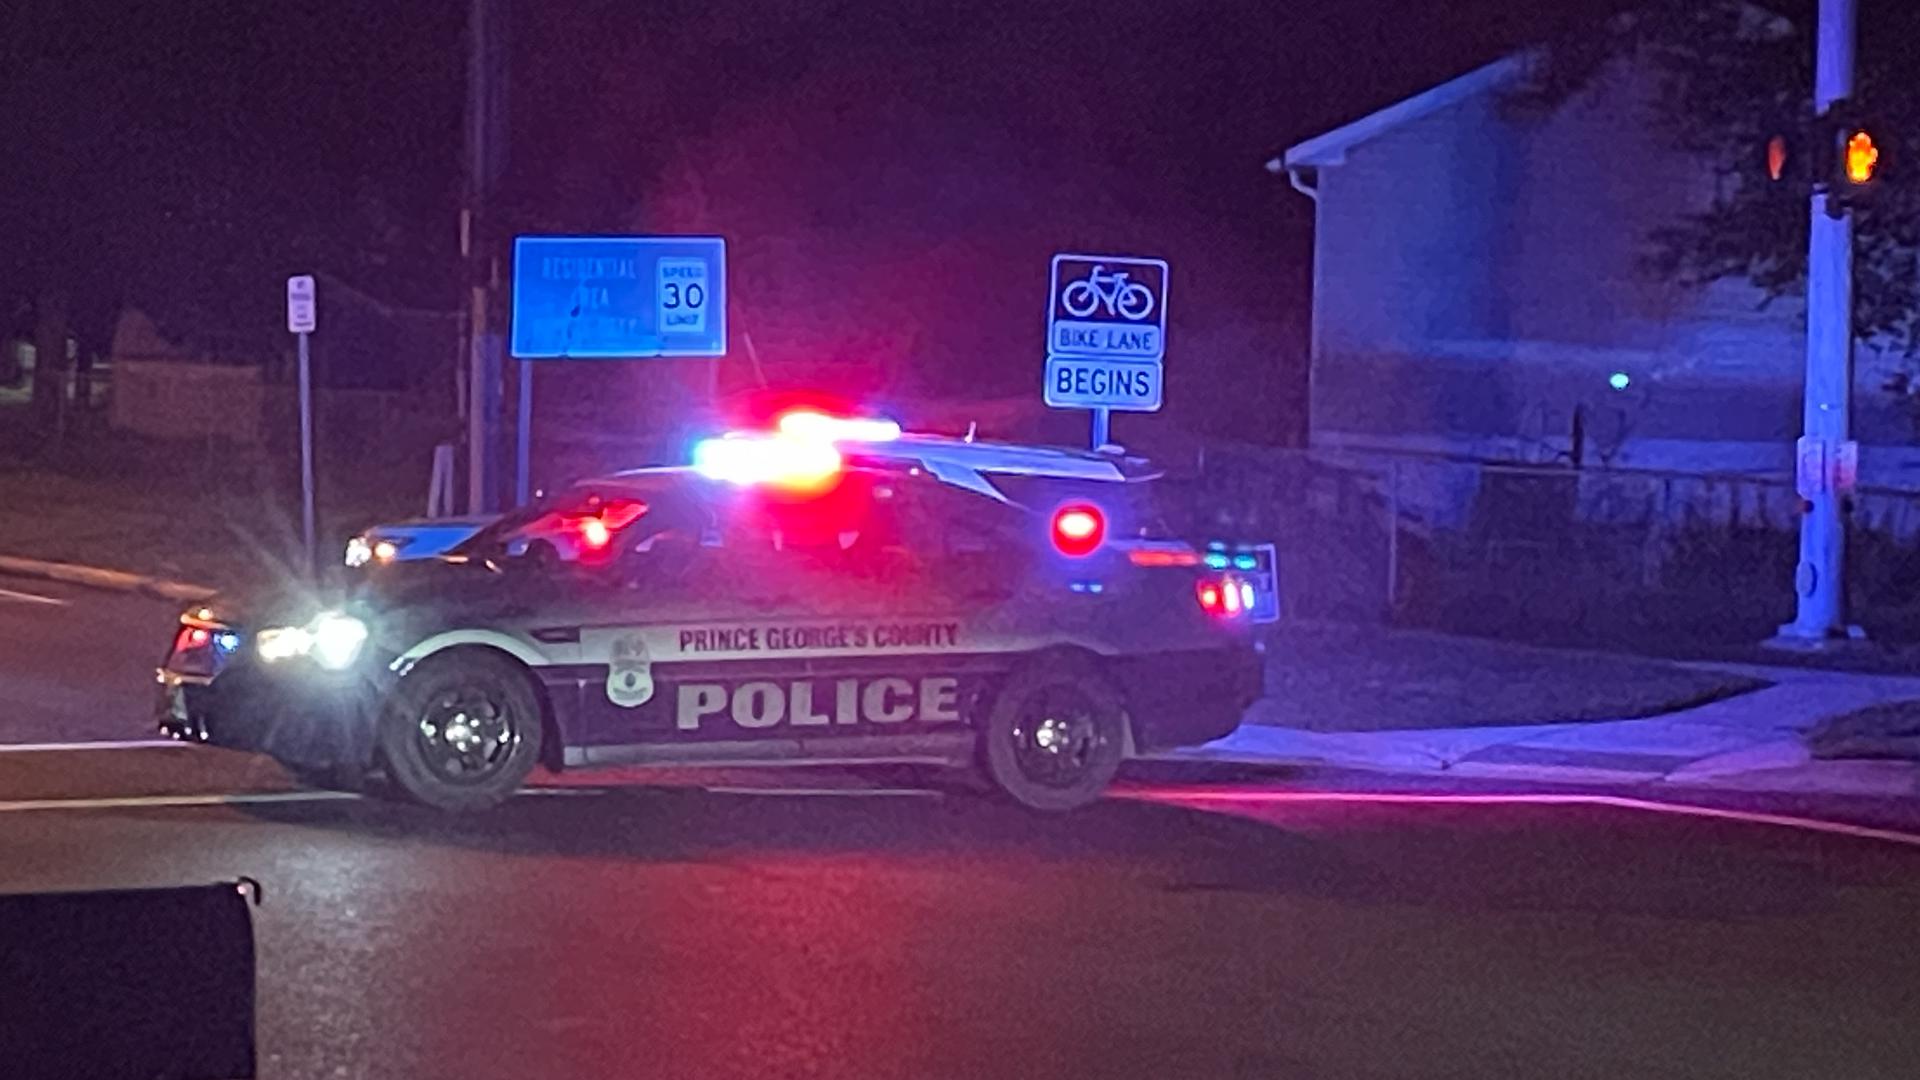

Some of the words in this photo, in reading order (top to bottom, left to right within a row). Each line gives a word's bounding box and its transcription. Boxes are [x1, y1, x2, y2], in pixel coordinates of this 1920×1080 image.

[663, 283, 704, 309] 30
[1060, 328, 1099, 347] BIKE
[1106, 331, 1154, 350] LANE
[1057, 367, 1150, 397] BEGINS
[680, 628, 760, 652] PRINCE
[766, 625, 868, 650] GEORGE'S
[874, 622, 958, 648] COUNTY
[677, 677, 960, 730] POLICE
